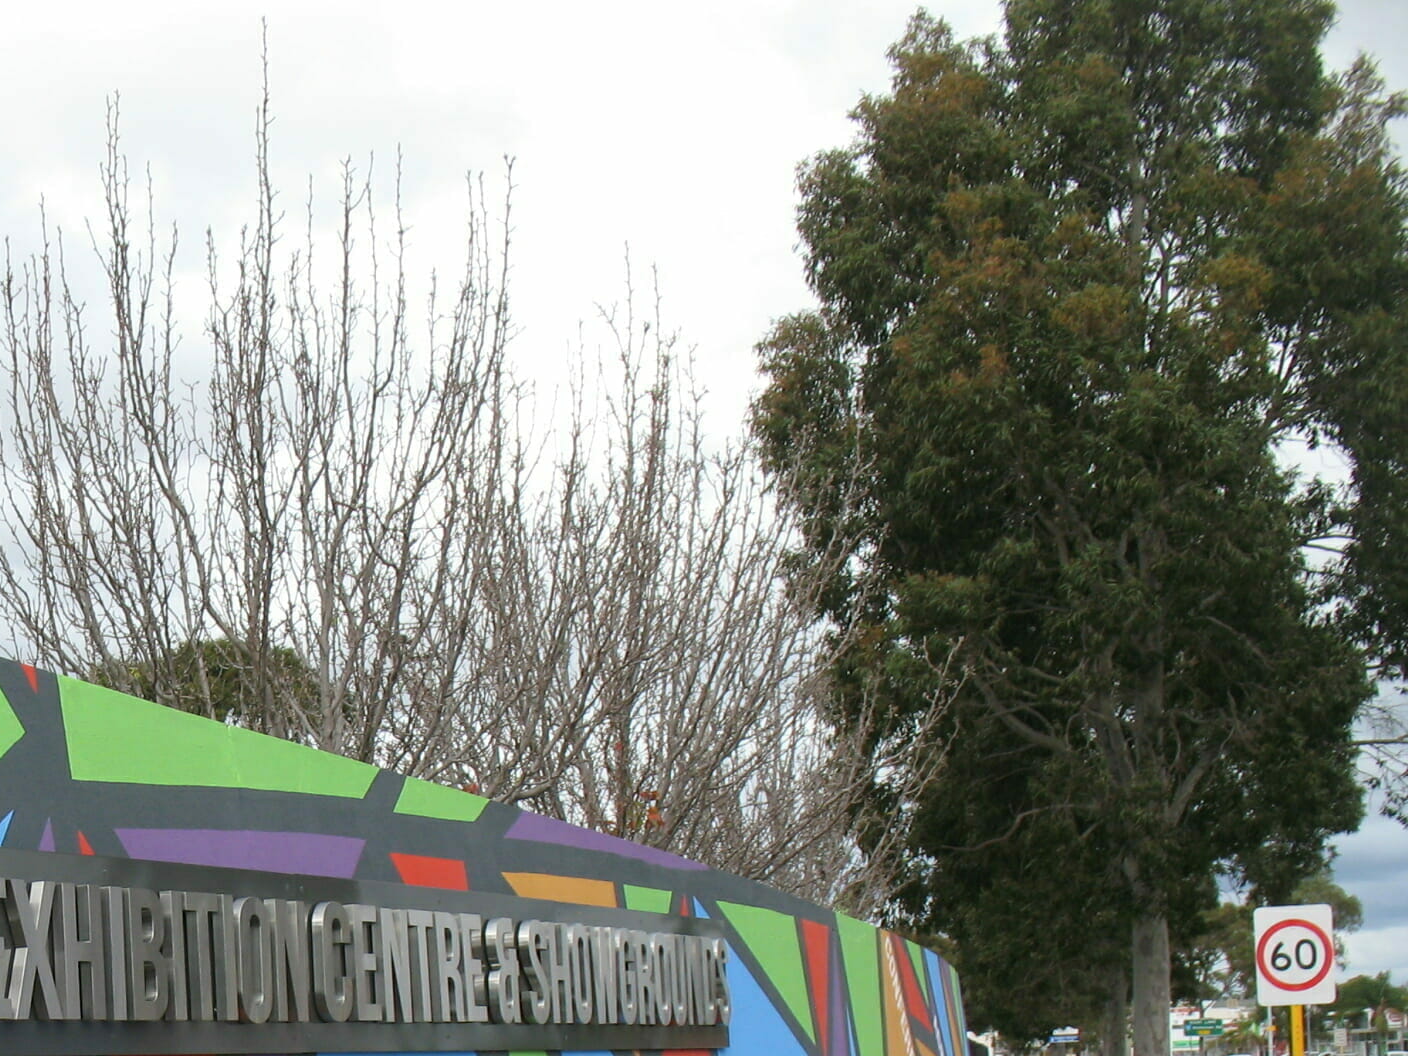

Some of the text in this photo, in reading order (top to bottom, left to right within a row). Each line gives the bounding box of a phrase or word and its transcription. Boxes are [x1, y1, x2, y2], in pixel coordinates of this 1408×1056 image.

[311, 901, 489, 1024] CENTRE
[485, 917, 523, 1025] &
[518, 919, 732, 1026] SHOWGROUNDS
[1271, 939, 1317, 972] 60
